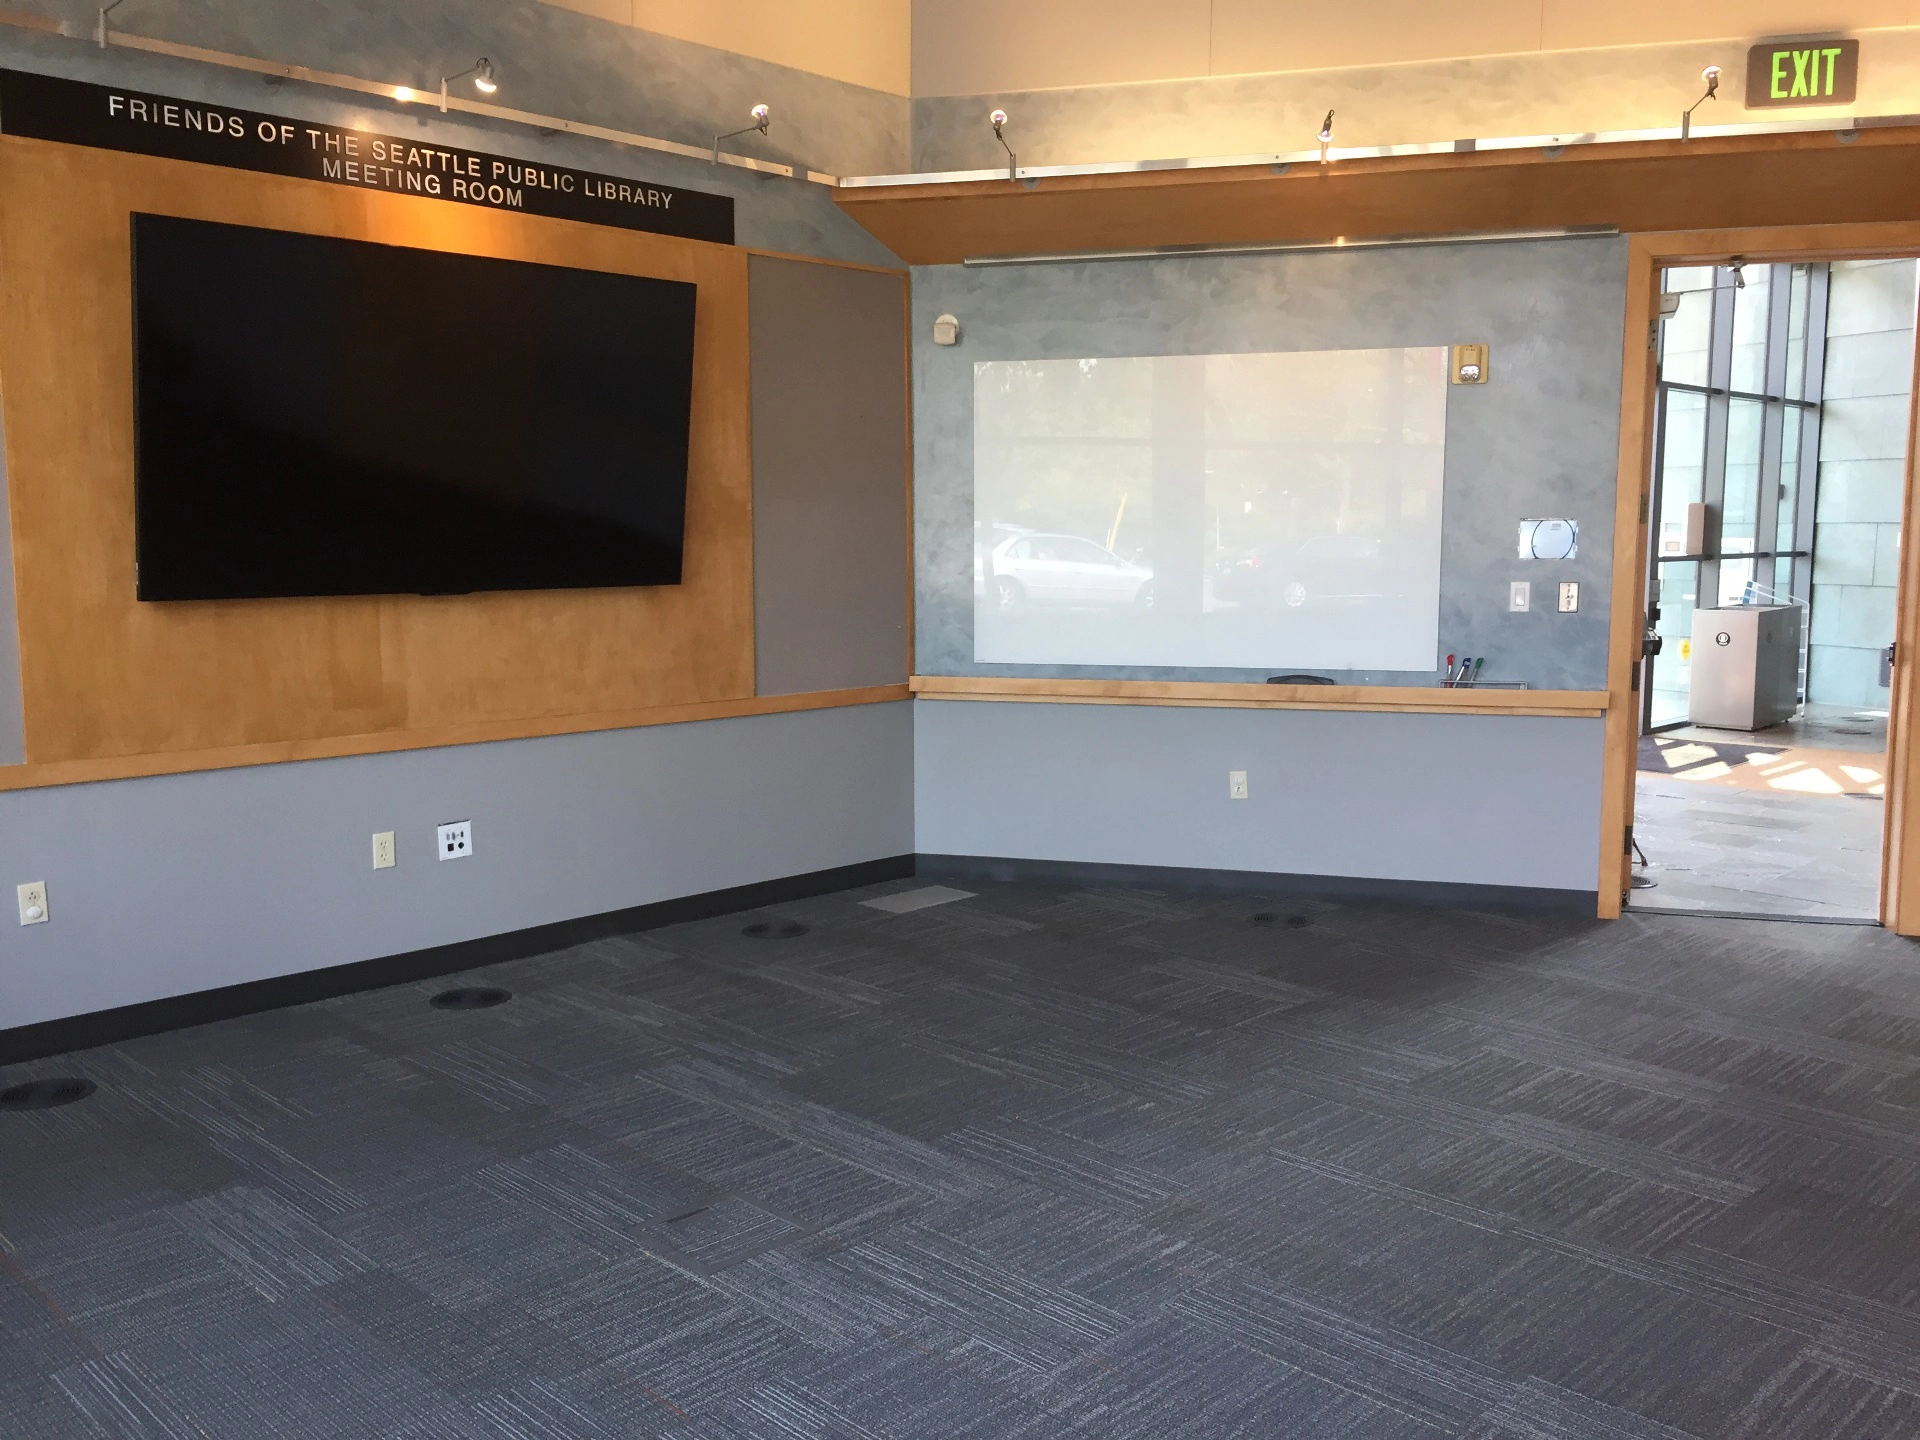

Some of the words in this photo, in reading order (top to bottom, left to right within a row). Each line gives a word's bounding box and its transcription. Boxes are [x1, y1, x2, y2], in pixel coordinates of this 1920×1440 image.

[1771, 48, 1842, 98] EXIT
[109, 95, 245, 137] FRIENDS
[257, 121, 295, 145] OF
[306, 129, 359, 156] THE
[372, 140, 481, 177] SEATTLE
[492, 161, 575, 193] PUBLIC
[584, 178, 673, 209] LIBRARY
[322, 157, 440, 194] MEETING
[453, 178, 523, 207] ROOM
